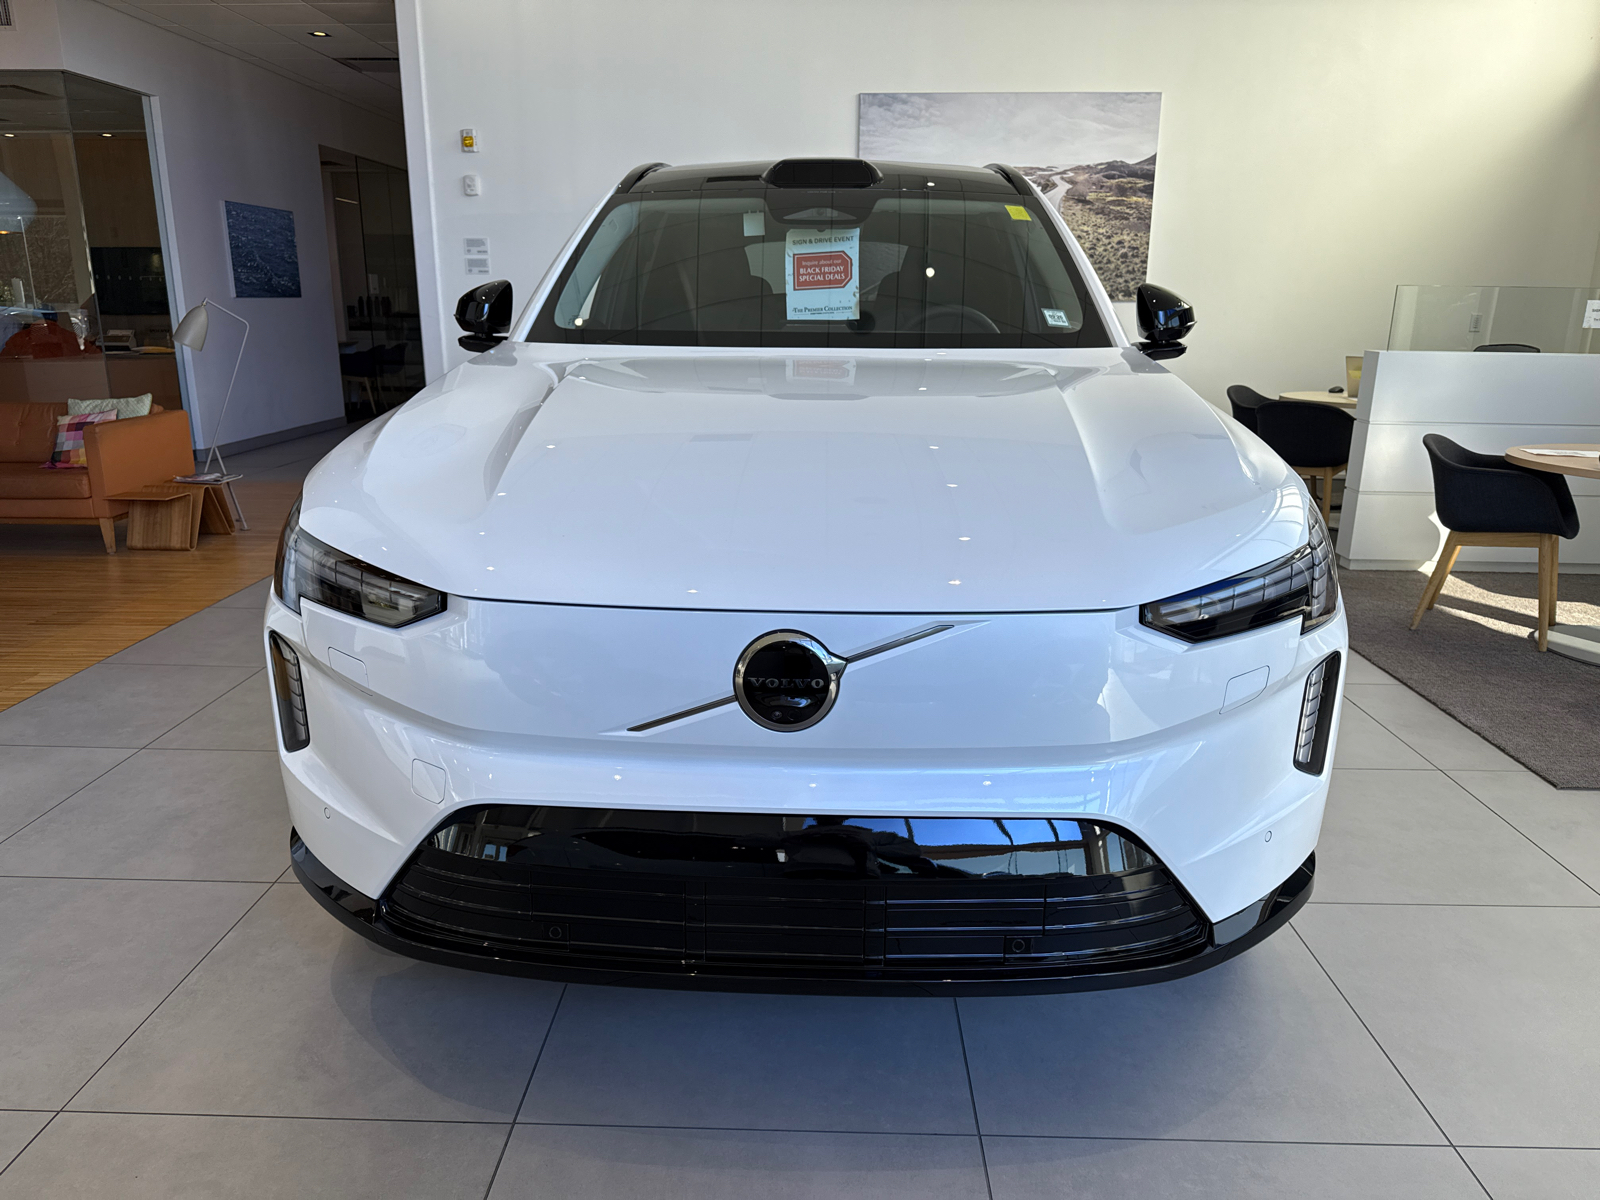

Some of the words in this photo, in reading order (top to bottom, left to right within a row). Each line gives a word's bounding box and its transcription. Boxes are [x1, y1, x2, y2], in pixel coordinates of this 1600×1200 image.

[799, 274, 824, 282] SPECIAL
[825, 273, 845, 281] DEALS
[748, 677, 825, 689] VOLVO
